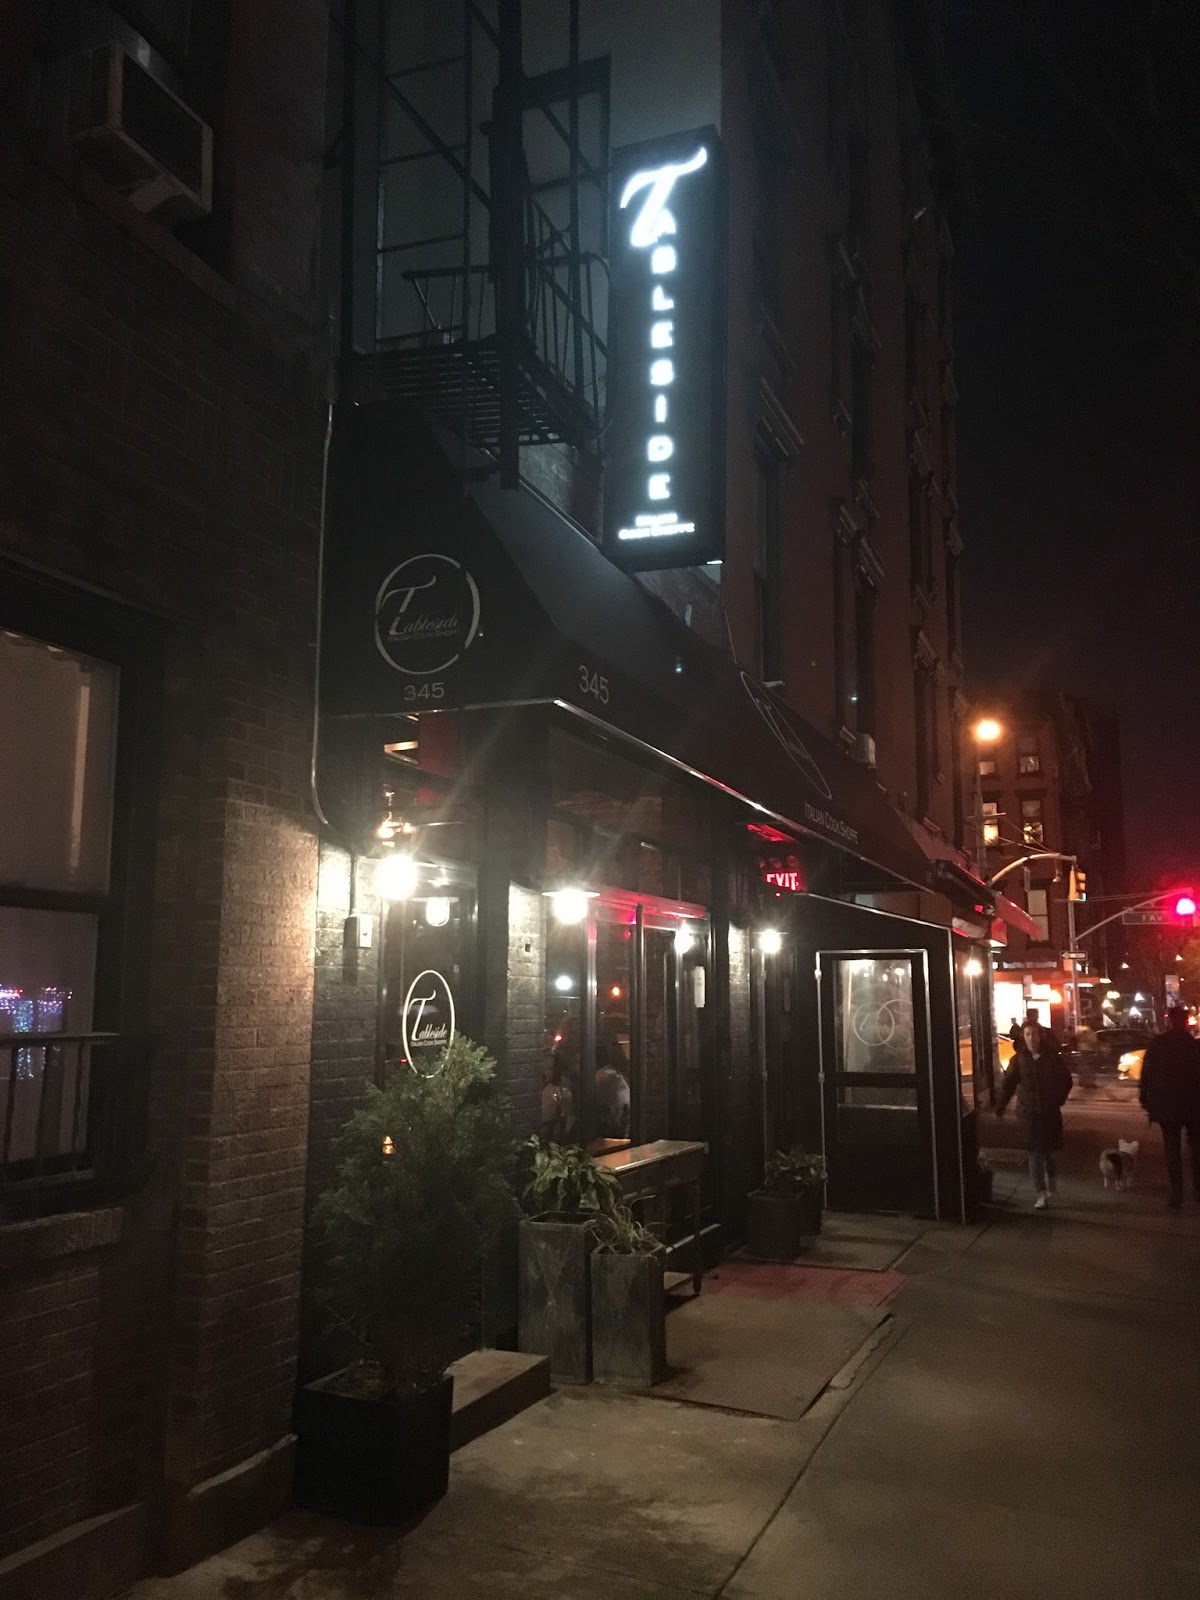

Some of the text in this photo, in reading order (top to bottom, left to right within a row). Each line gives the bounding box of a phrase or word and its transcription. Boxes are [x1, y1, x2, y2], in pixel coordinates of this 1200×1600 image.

[403, 681, 445, 701] 345
[578, 664, 610, 704] 345
[407, 989, 448, 1041] Tableside
